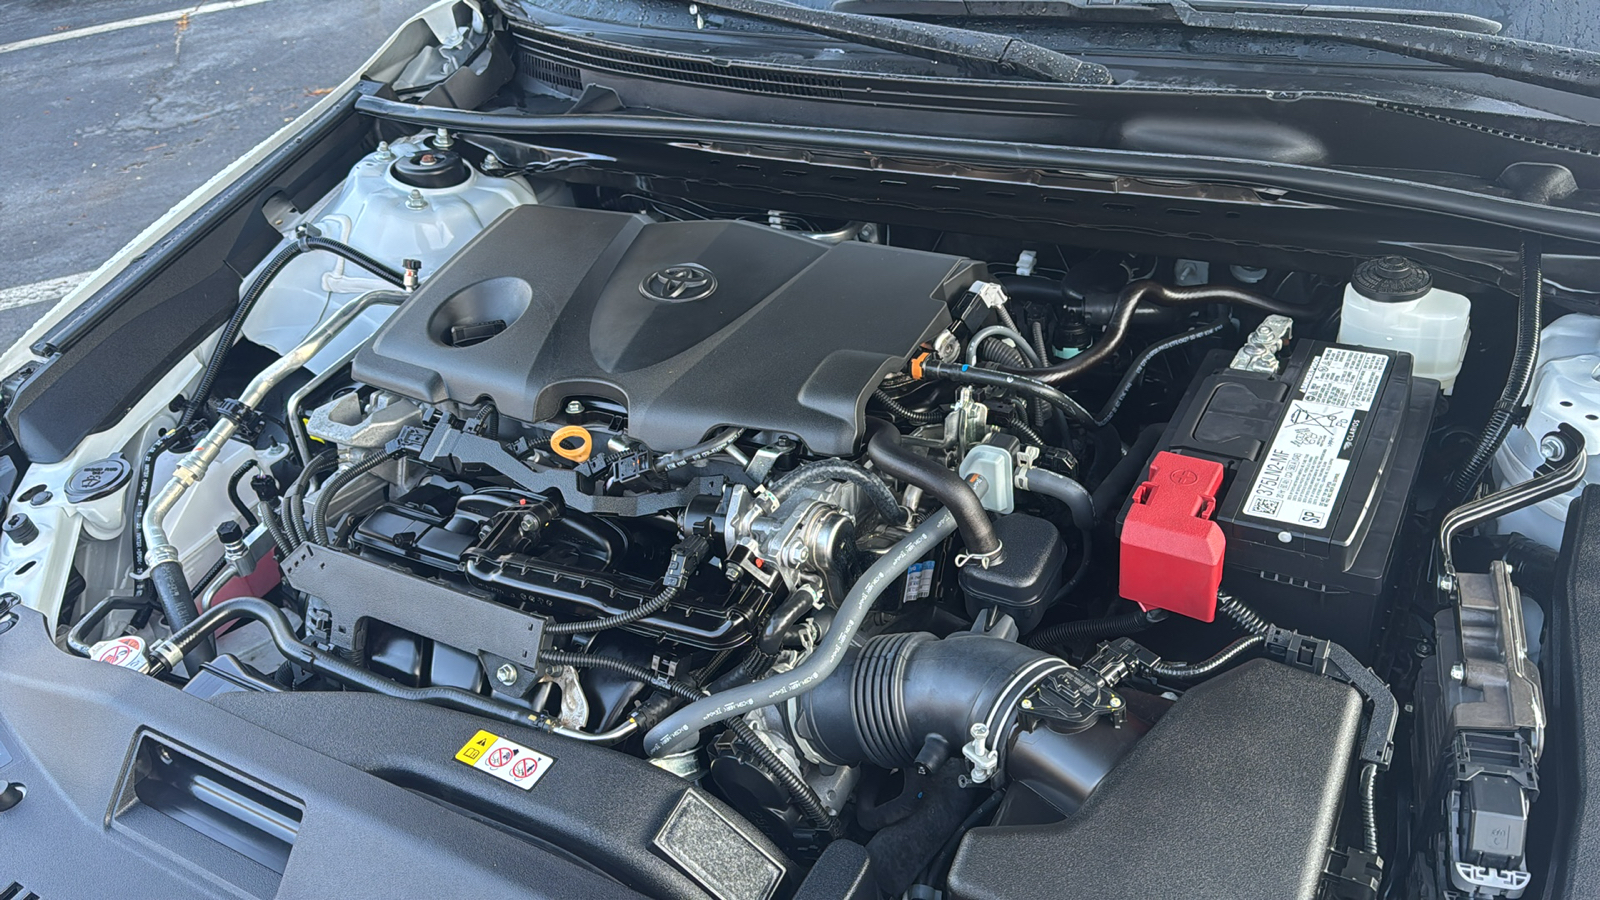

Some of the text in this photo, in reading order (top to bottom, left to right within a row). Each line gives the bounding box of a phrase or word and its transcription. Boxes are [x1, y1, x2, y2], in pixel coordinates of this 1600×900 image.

[1346, 419, 1361, 441] CLARIOS
[142, 463, 150, 479] WATER
[1255, 449, 1290, 497] 375LN2-MF
[1302, 511, 1322, 524] SP
